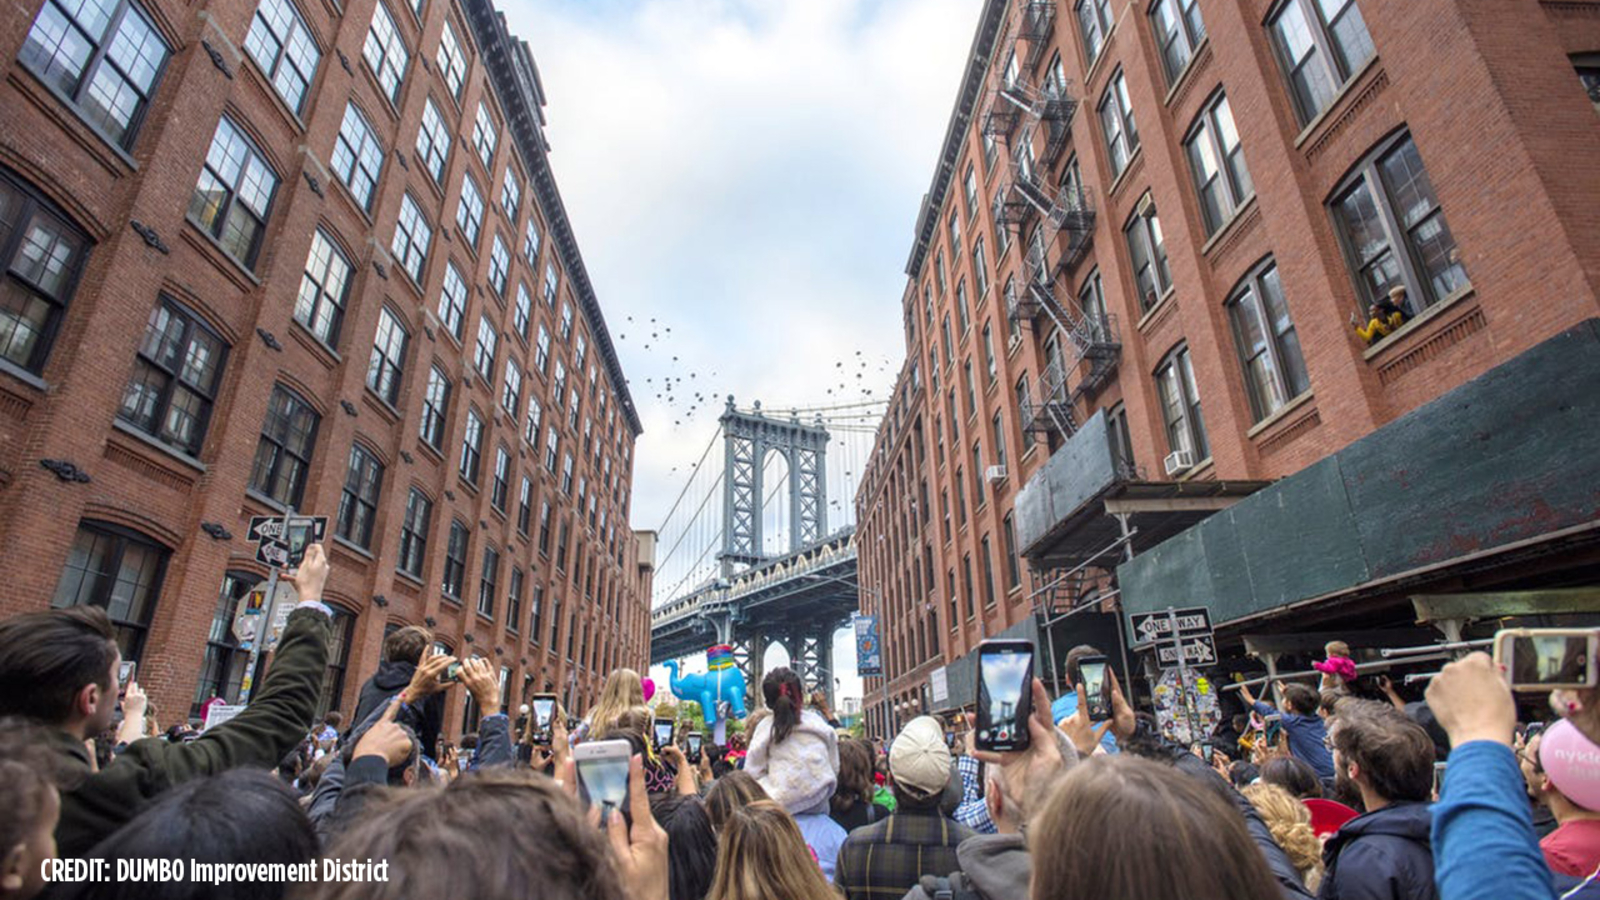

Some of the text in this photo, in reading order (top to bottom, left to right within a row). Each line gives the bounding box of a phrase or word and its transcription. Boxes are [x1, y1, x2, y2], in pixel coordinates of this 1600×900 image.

[260, 523, 284, 535] ONE
[1144, 616, 1200, 633] ONE WAY
[1163, 643, 1205, 661] ON WAY
